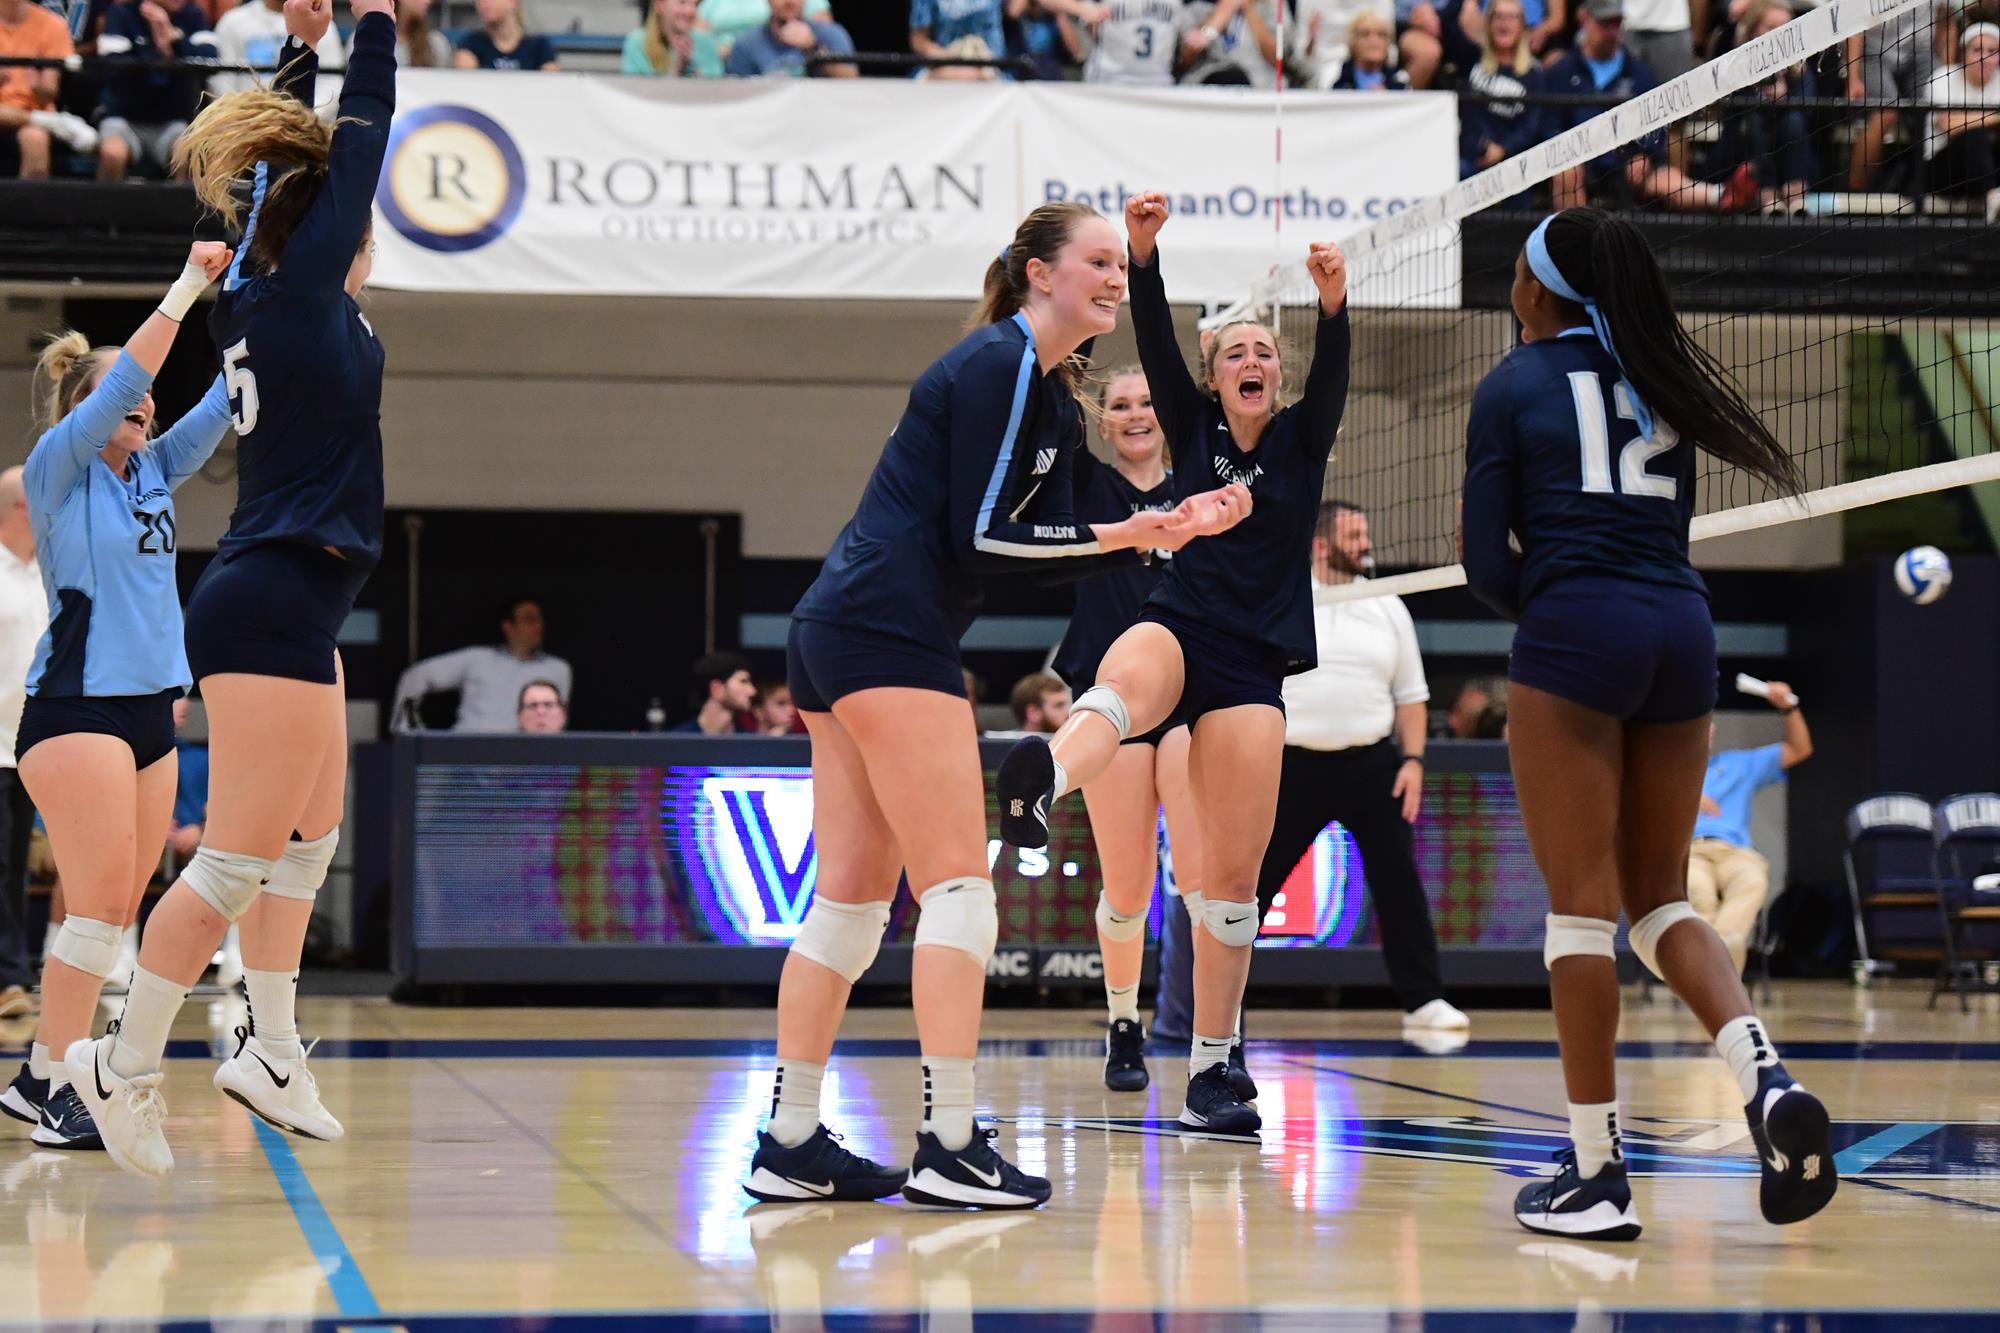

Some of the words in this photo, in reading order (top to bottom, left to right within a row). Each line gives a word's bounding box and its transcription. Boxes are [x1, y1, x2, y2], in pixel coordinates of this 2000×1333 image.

[1134, 25, 1153, 59] 3
[1745, 22, 1806, 76] VILLANOVA
[427, 151, 474, 203] R
[545, 156, 985, 210] ROTHMAN
[602, 212, 933, 244] ORTHOPAEDICS
[222, 336, 260, 437] 5
[1566, 371, 1680, 501] 12
[132, 507, 176, 557] 20
[1033, 524, 1078, 539] NATION
[986, 950, 1031, 978] NC
[1040, 950, 1104, 979] ANC
